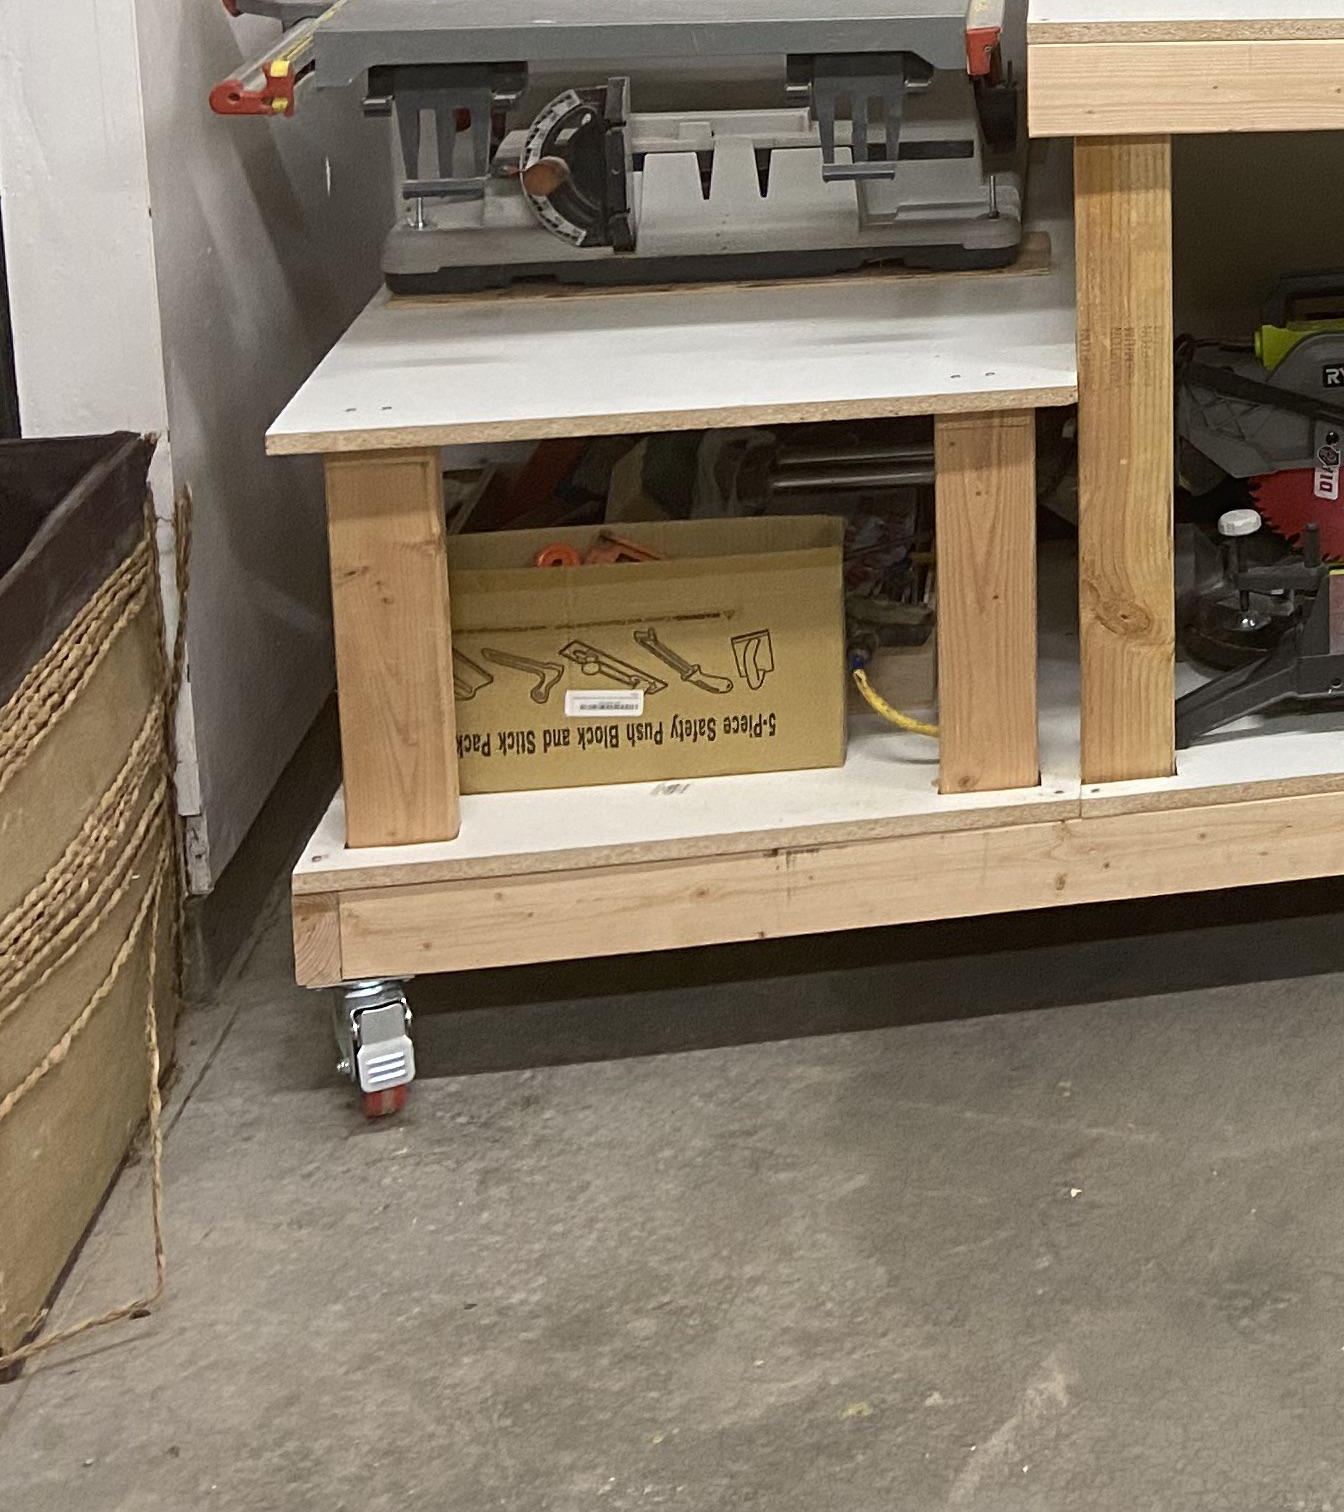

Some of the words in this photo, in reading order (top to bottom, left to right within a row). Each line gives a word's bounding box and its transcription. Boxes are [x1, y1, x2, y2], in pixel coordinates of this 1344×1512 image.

[577, 724, 619, 750] Block
[626, 721, 664, 747] Push
[670, 714, 716, 743] Safety
[723, 712, 776, 738] 5-Piece
[456, 732, 492, 759] Pack
[498, 729, 536, 756] Stick
[543, 727, 570, 753] and
